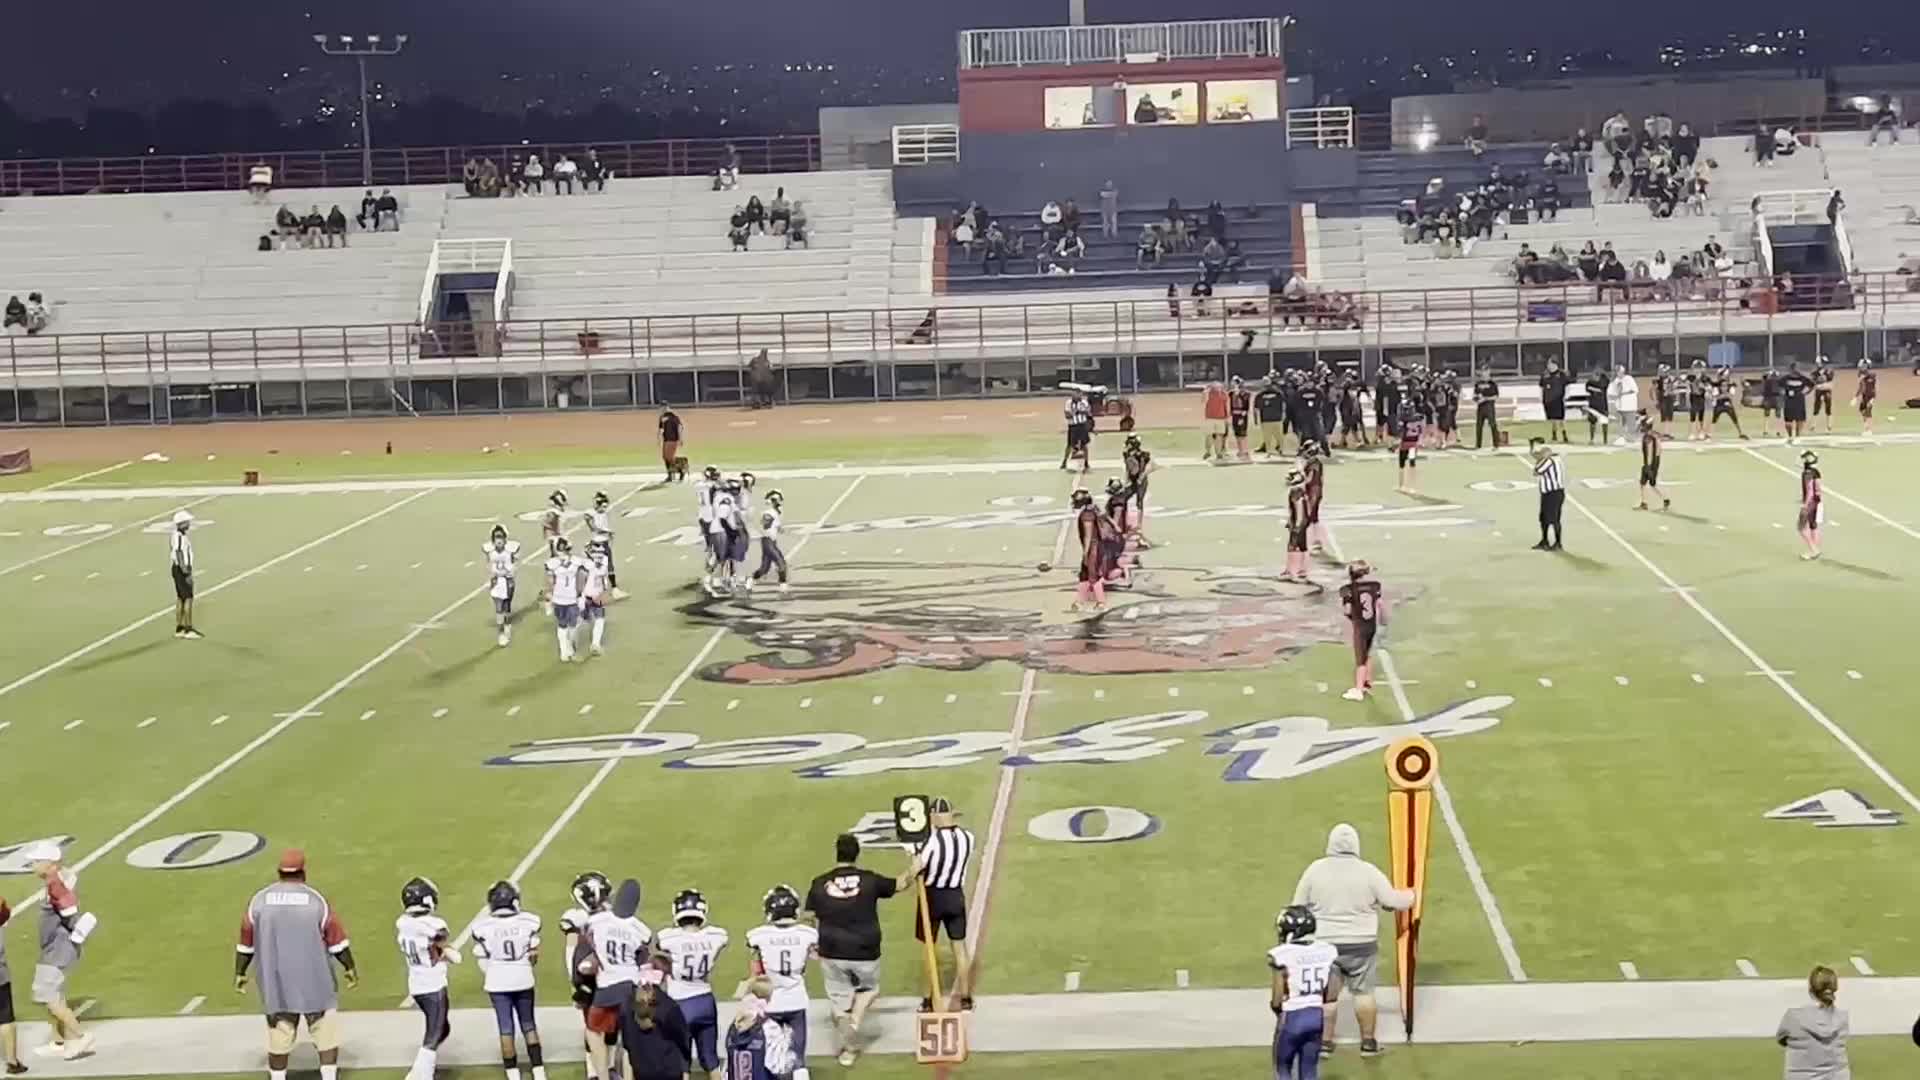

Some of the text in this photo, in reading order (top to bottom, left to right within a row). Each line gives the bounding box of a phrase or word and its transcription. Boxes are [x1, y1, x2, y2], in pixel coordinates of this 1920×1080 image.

[1360, 592, 1374, 620] 3
[900, 797, 927, 833] 3
[1763, 788, 1906, 827] 4
[1028, 806, 1160, 843] 0
[126, 831, 266, 869] 0
[503, 940, 517, 962] 9
[780, 949, 792, 976] 6
[681, 954, 710, 981] 54
[1299, 967, 1324, 996] 55
[919, 1018, 960, 1057] 50
